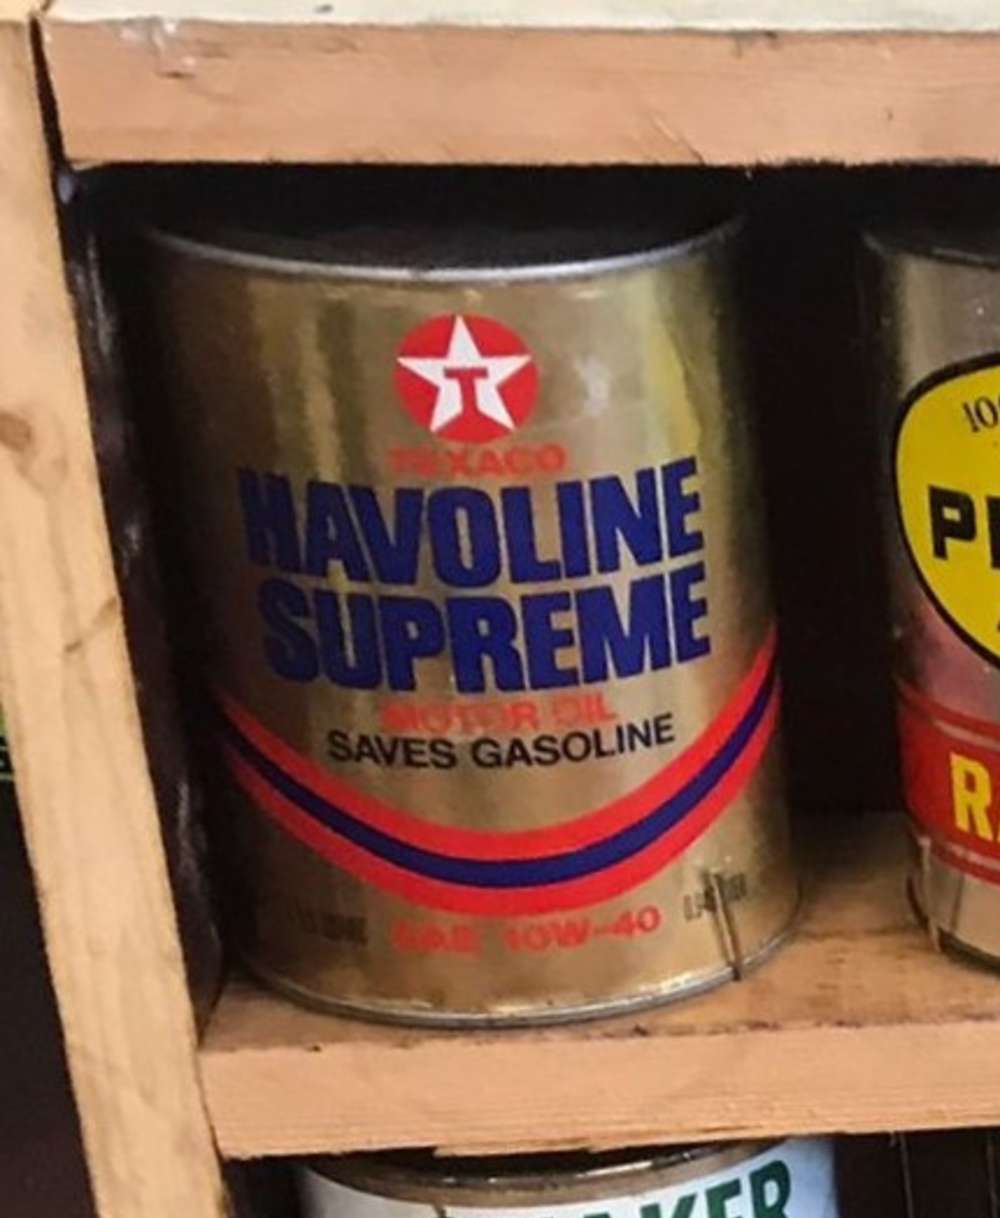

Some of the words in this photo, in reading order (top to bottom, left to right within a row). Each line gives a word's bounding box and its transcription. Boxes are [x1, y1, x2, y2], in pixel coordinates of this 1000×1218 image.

[388, 444, 568, 478] TEXACO
[237, 456, 704, 588] HAVOLINE
[258, 563, 711, 694] SUPREME
[554, 690, 618, 728] OIL
[327, 730, 457, 769] SAVES
[471, 713, 677, 769] GASOLINE
[503, 905, 662, 950] 10W-40
